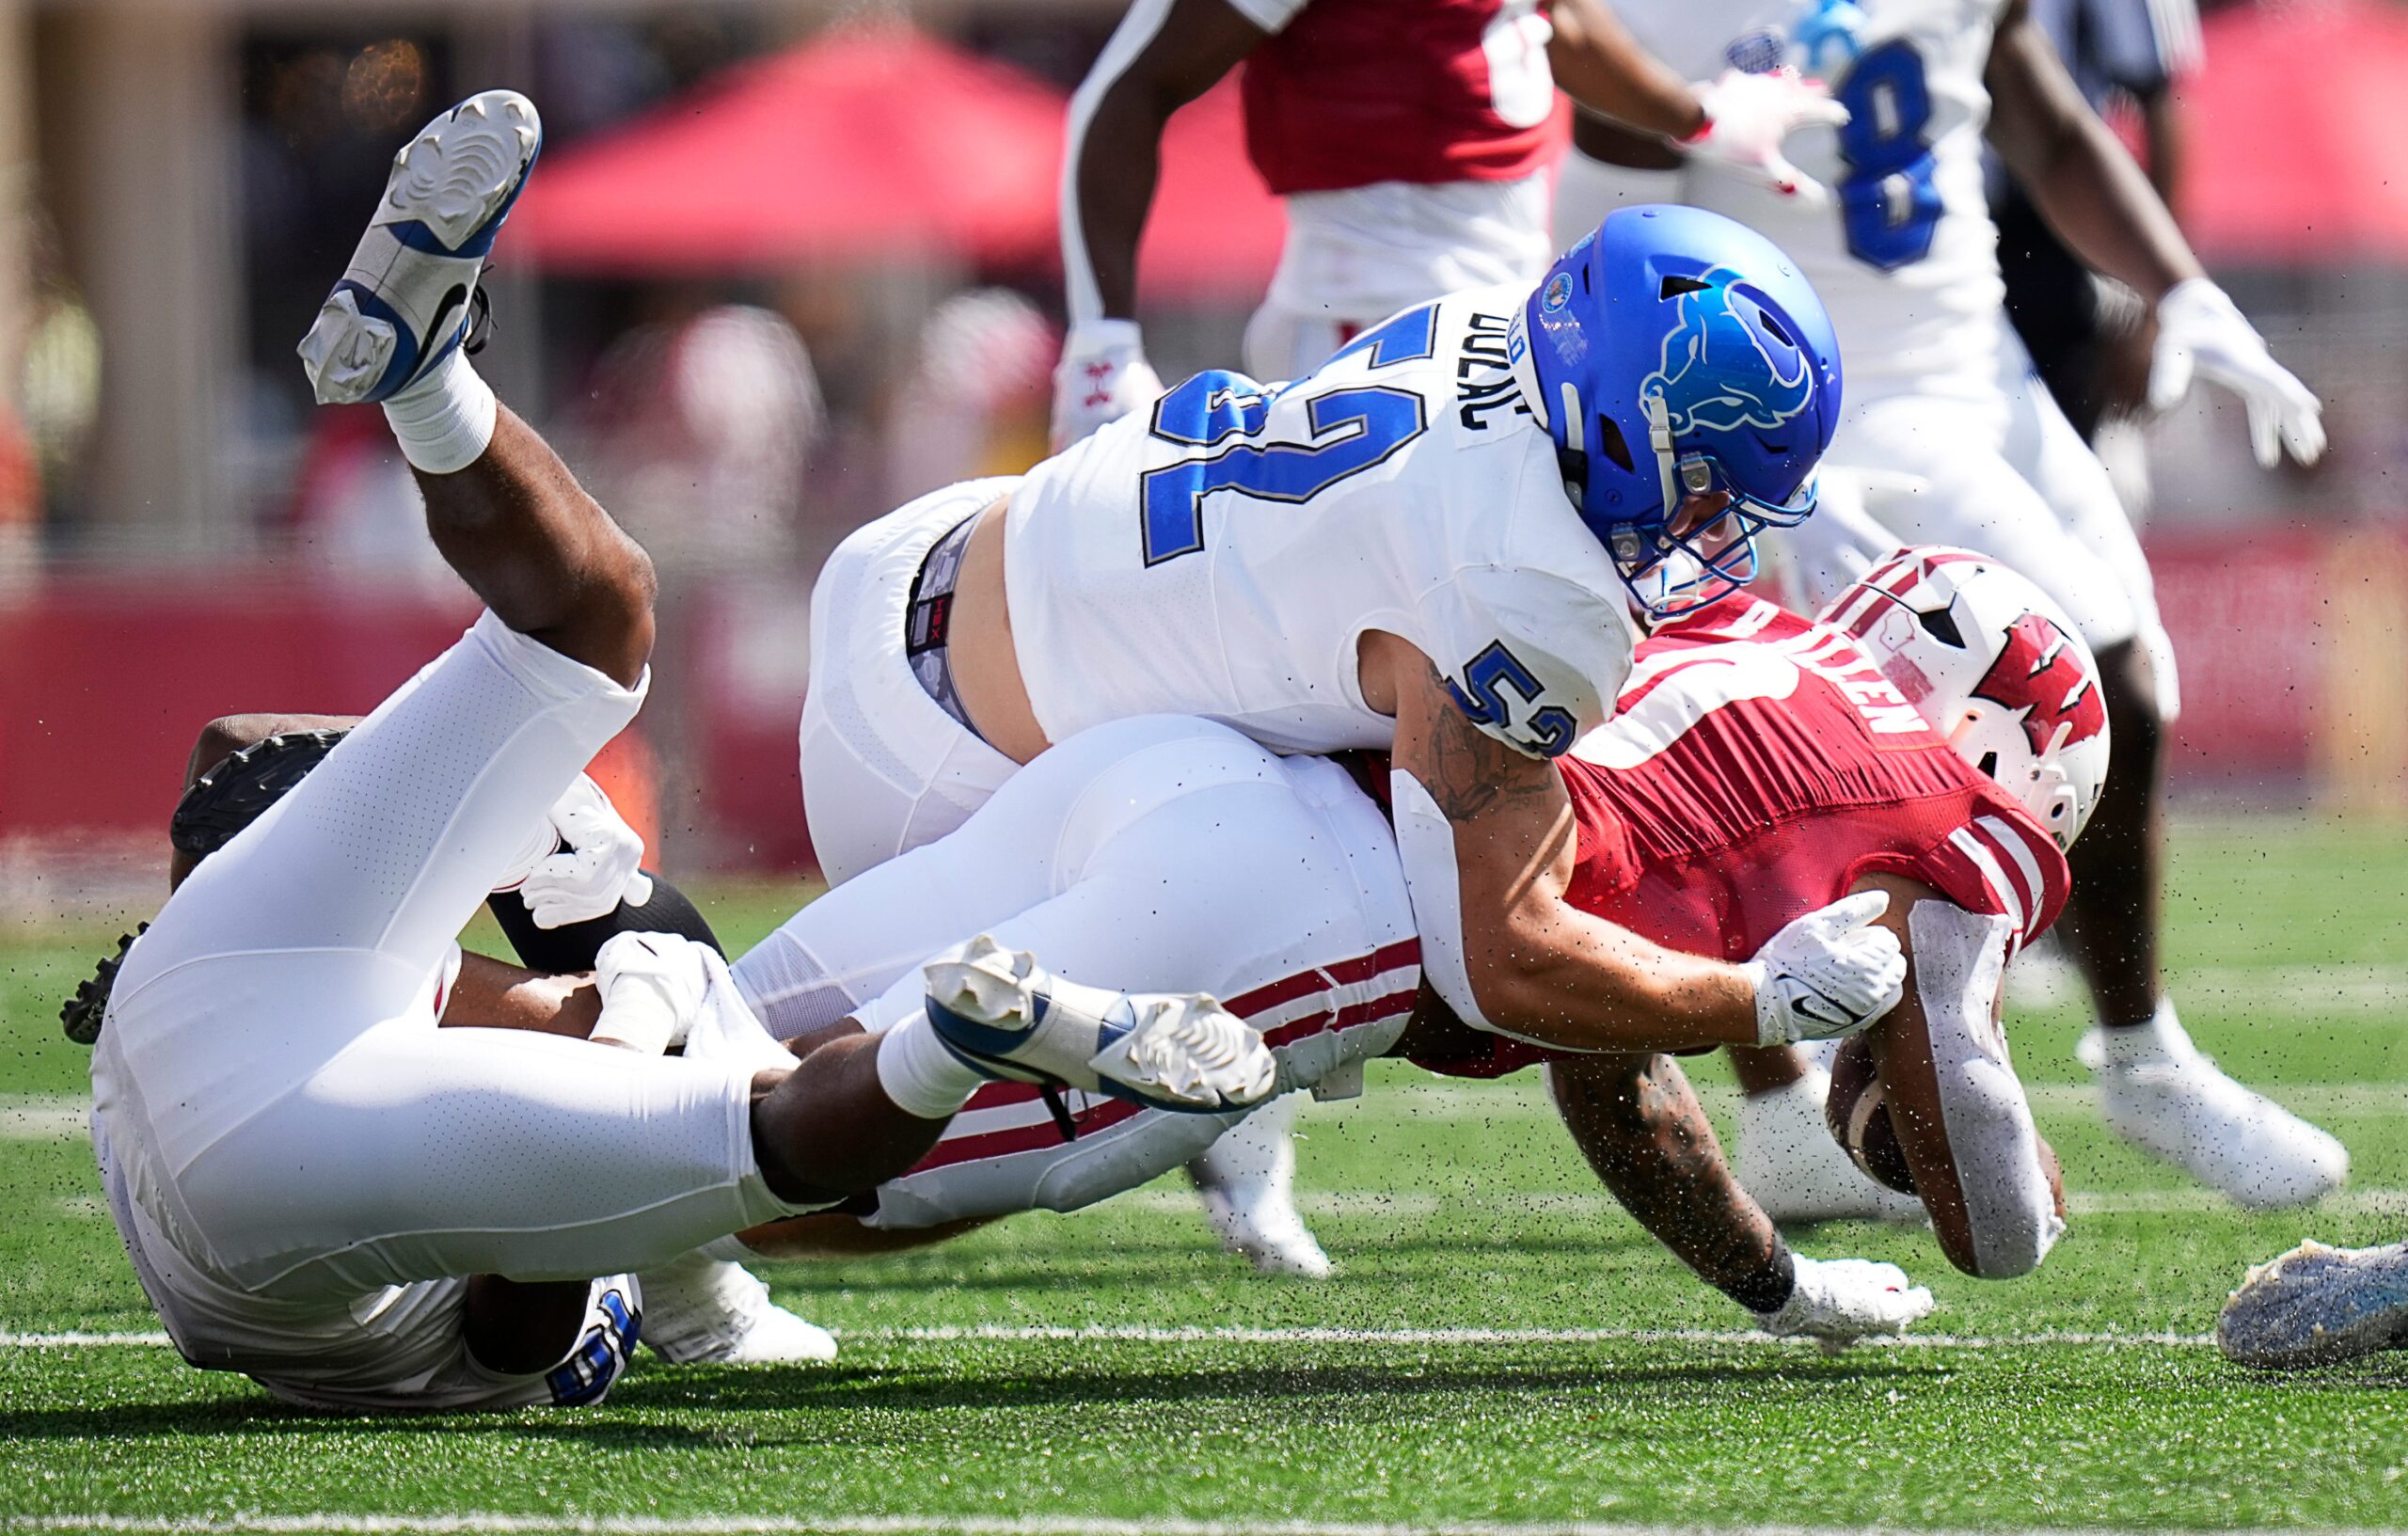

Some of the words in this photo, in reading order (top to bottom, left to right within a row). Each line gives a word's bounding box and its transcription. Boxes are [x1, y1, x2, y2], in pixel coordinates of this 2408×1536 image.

[1835, 37, 1943, 271] 8
[1140, 303, 1441, 568] 52
[1457, 312, 1533, 431] DOLAC
